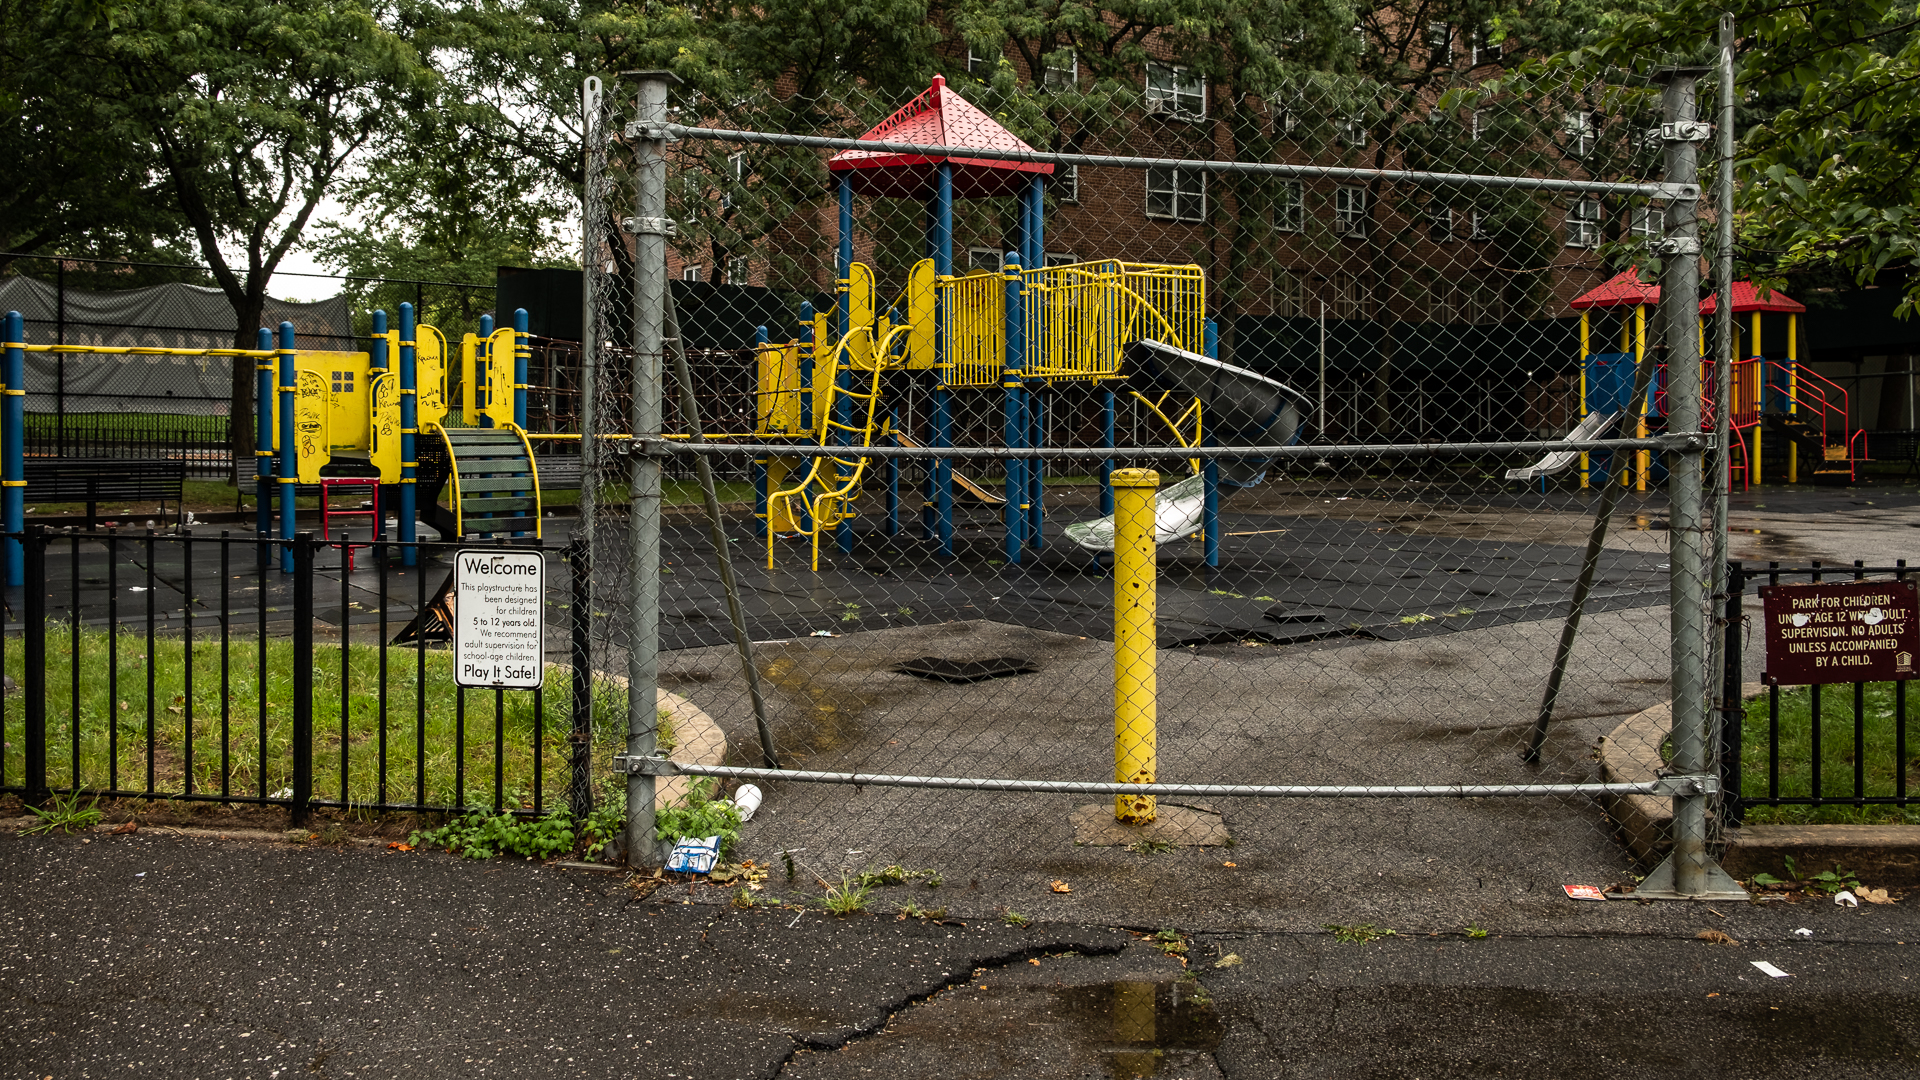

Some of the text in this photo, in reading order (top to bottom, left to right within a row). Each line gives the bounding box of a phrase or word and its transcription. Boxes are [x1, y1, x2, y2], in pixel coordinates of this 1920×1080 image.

[465, 558, 537, 575] Welcome
[461, 582, 537, 593] This playstructure has
[484, 594, 537, 605] been designed
[1792, 595, 1890, 609] PARK FOR CHILDREN
[496, 606, 537, 615] for children
[473, 617, 537, 628] 5 to 12 years old.
[1778, 613, 1811, 625] UNR
[1815, 612, 1833, 622] AGE
[1836, 612, 1846, 622] 12
[1873, 609, 1906, 619] DULT
[480, 629, 537, 639] We recommend
[1782, 624, 1904, 639] SUPERVISION. NO ADULTS
[464, 640, 537, 650] adult supervision for
[1789, 639, 1898, 653] UNLESS ACCOMPANIED
[464, 652, 536, 662] school-age children.
[1816, 655, 1872, 667] BY A CHILD.
[464, 665, 536, 680] Play It Safe!
